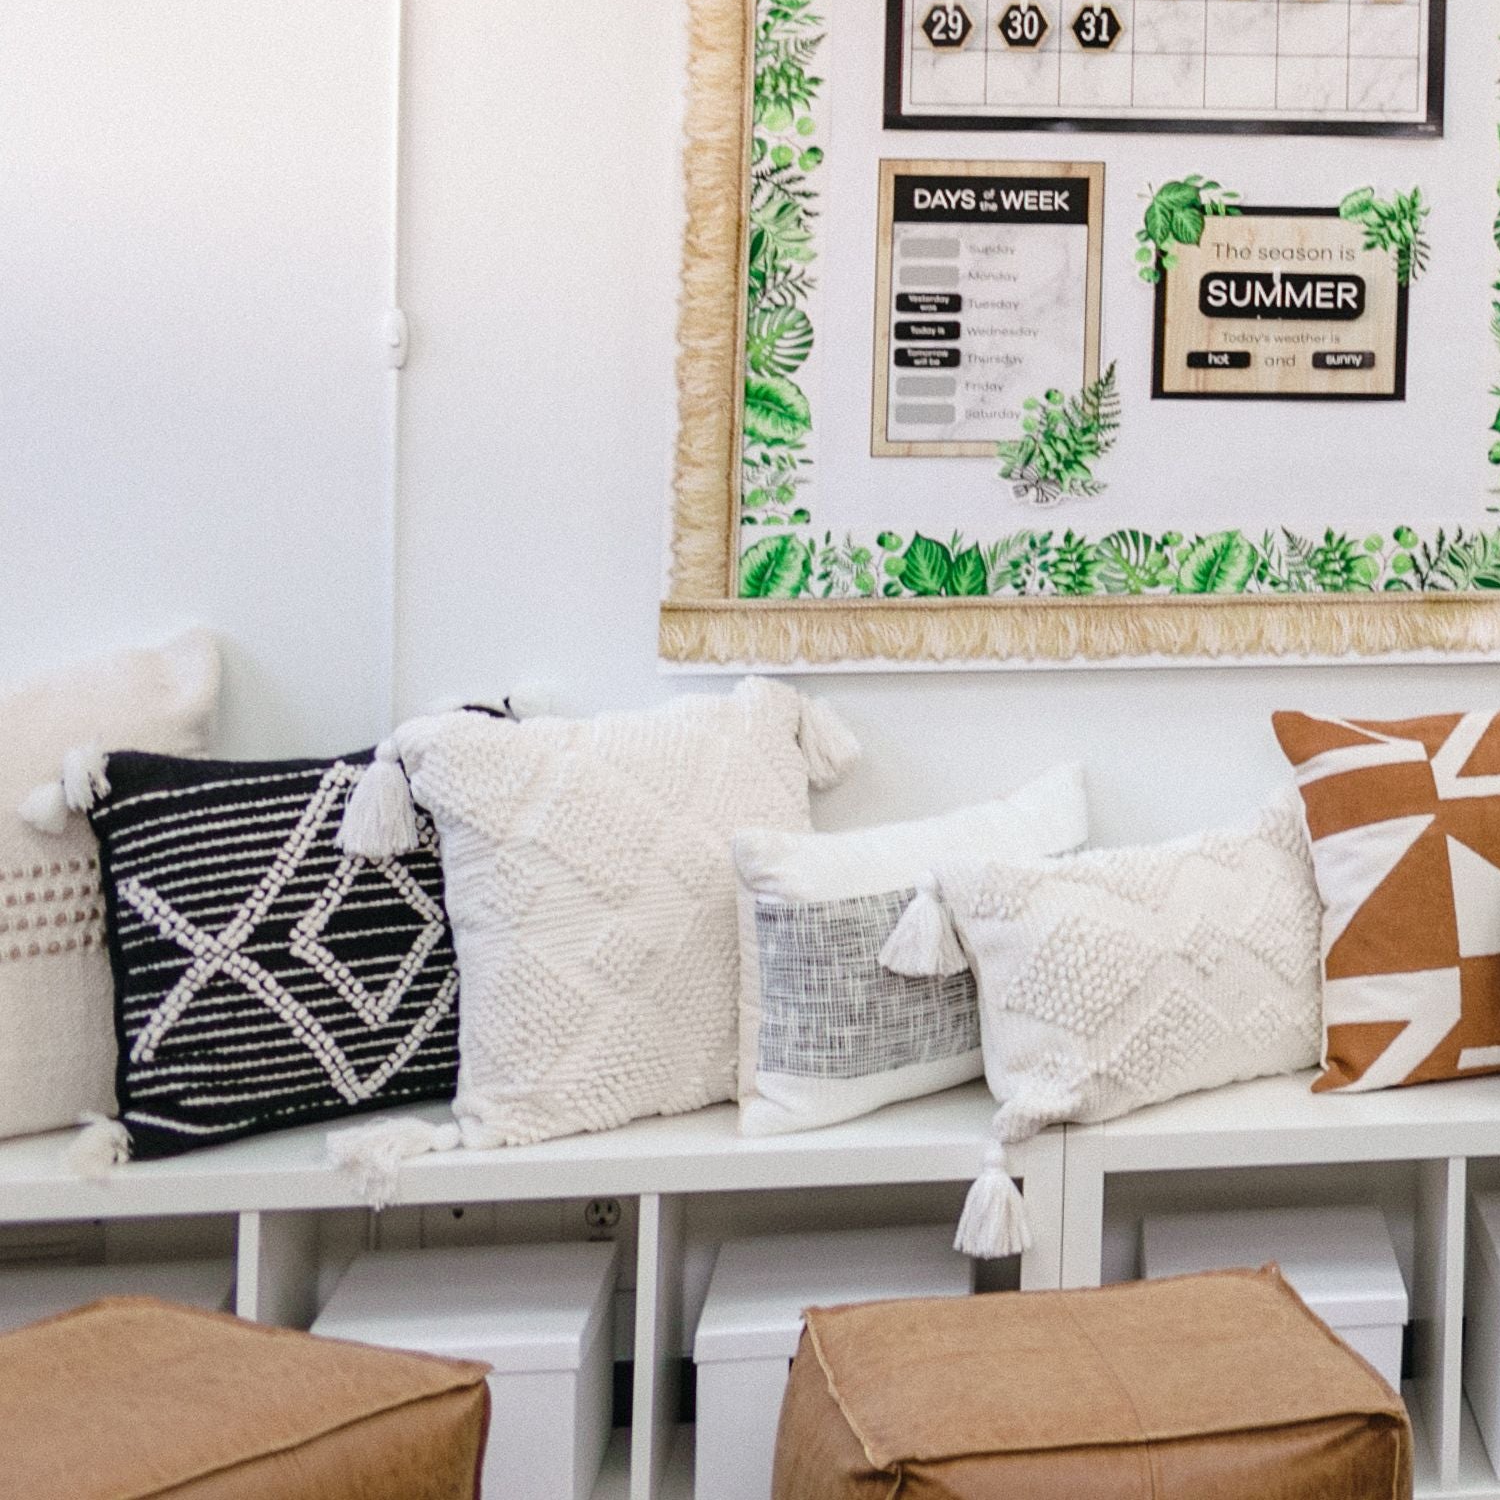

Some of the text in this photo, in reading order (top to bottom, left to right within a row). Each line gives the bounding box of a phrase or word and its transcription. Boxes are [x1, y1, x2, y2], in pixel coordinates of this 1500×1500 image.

[931, 10, 1110, 42] 29 30 31
[914, 188, 1070, 212] DAYS of the WEEK
[969, 243, 1015, 255] Sunday
[1212, 241, 1355, 261] The season is
[967, 271, 1017, 283] Monday
[1207, 278, 1358, 309] SUMMER
[968, 299, 1019, 311] Tuesday
[966, 327, 1038, 338] Wednesday
[1223, 332, 1340, 344] Today's weather is
[966, 353, 1023, 365] Thursday
[1208, 353, 1363, 368] hot and sunny
[965, 381, 1004, 393] Friday
[965, 409, 1021, 420] Saturday
